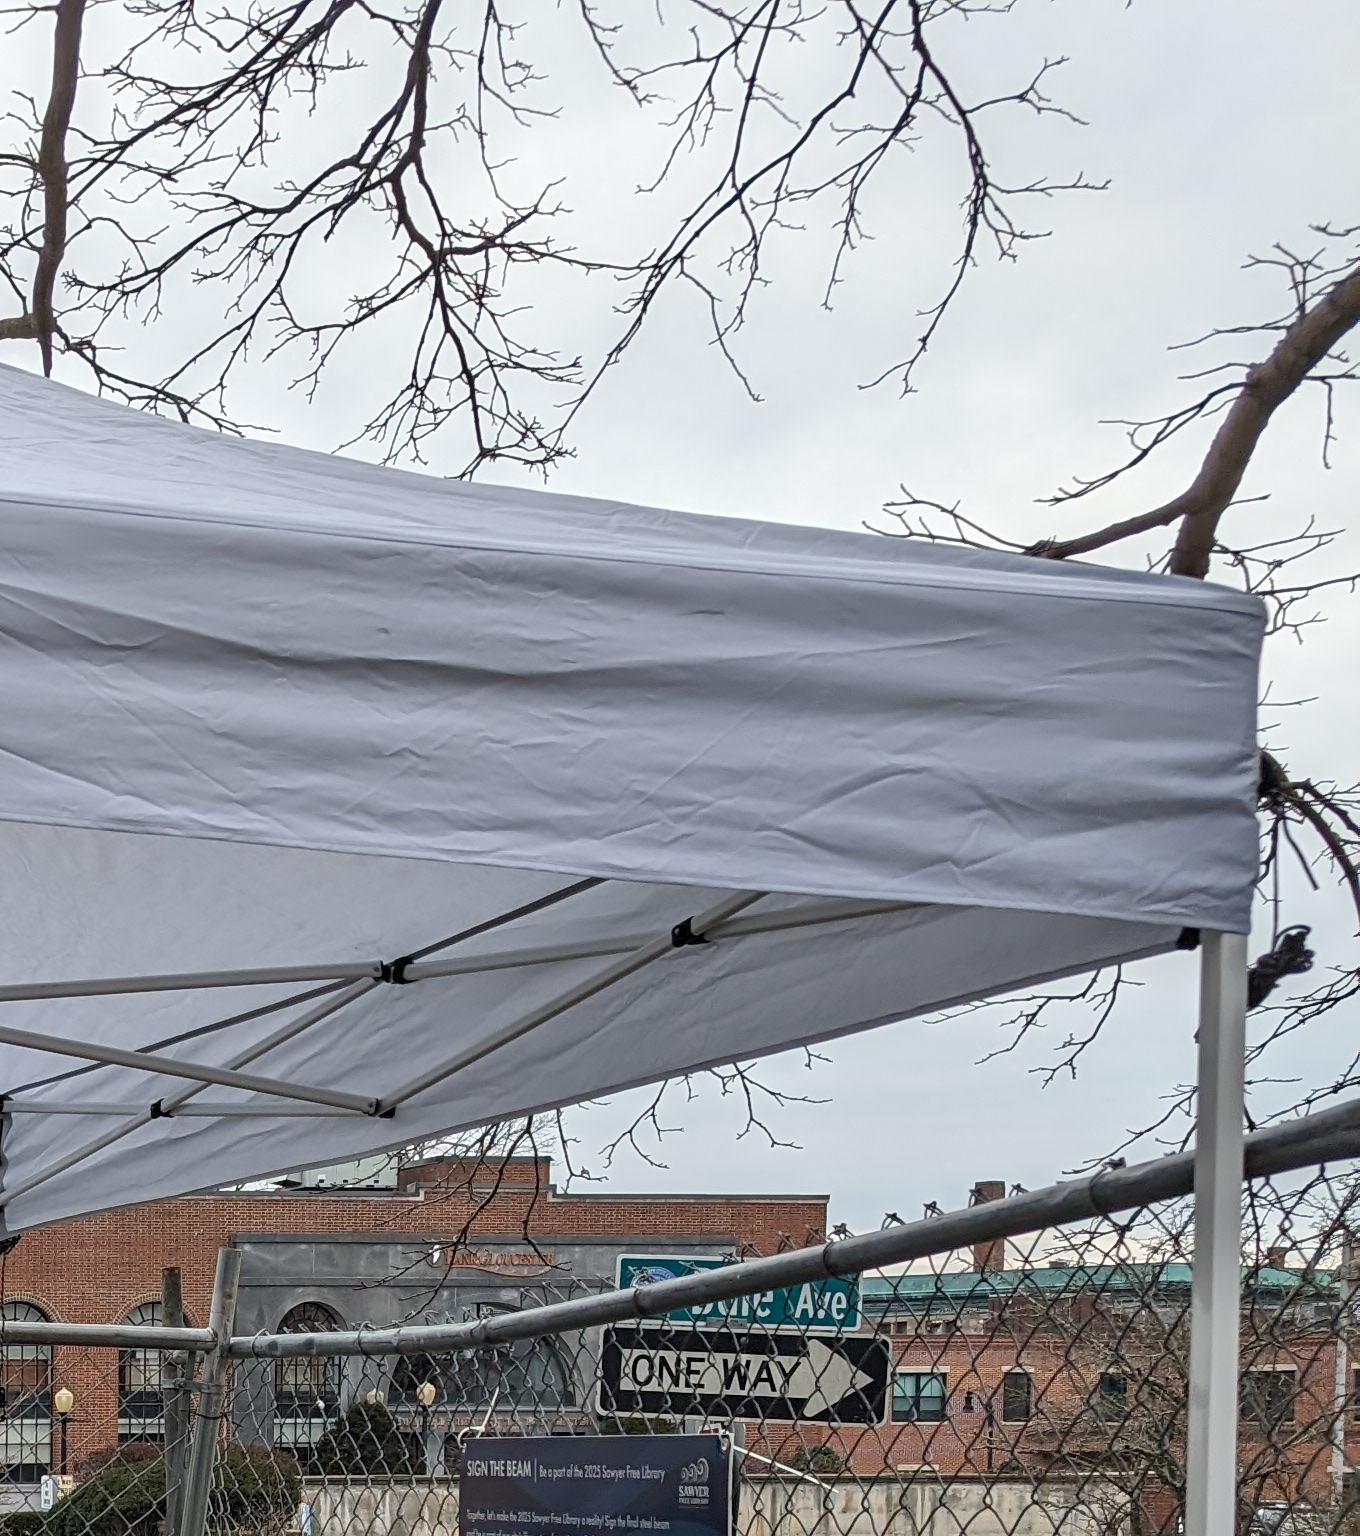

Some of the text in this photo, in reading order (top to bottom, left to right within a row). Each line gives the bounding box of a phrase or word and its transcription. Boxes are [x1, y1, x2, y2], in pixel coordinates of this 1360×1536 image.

[795, 1283, 847, 1320] Ave
[631, 1354, 802, 1393] ONE WAY
[467, 1460, 531, 1476] SIGN THE BEAM
[539, 1465, 665, 1482] Be a part of the 2025 Sawyer Free Library
[604, 1515, 616, 1530] Sign
[640, 1517, 652, 1529] steel
[653, 1518, 669, 1530] beam
